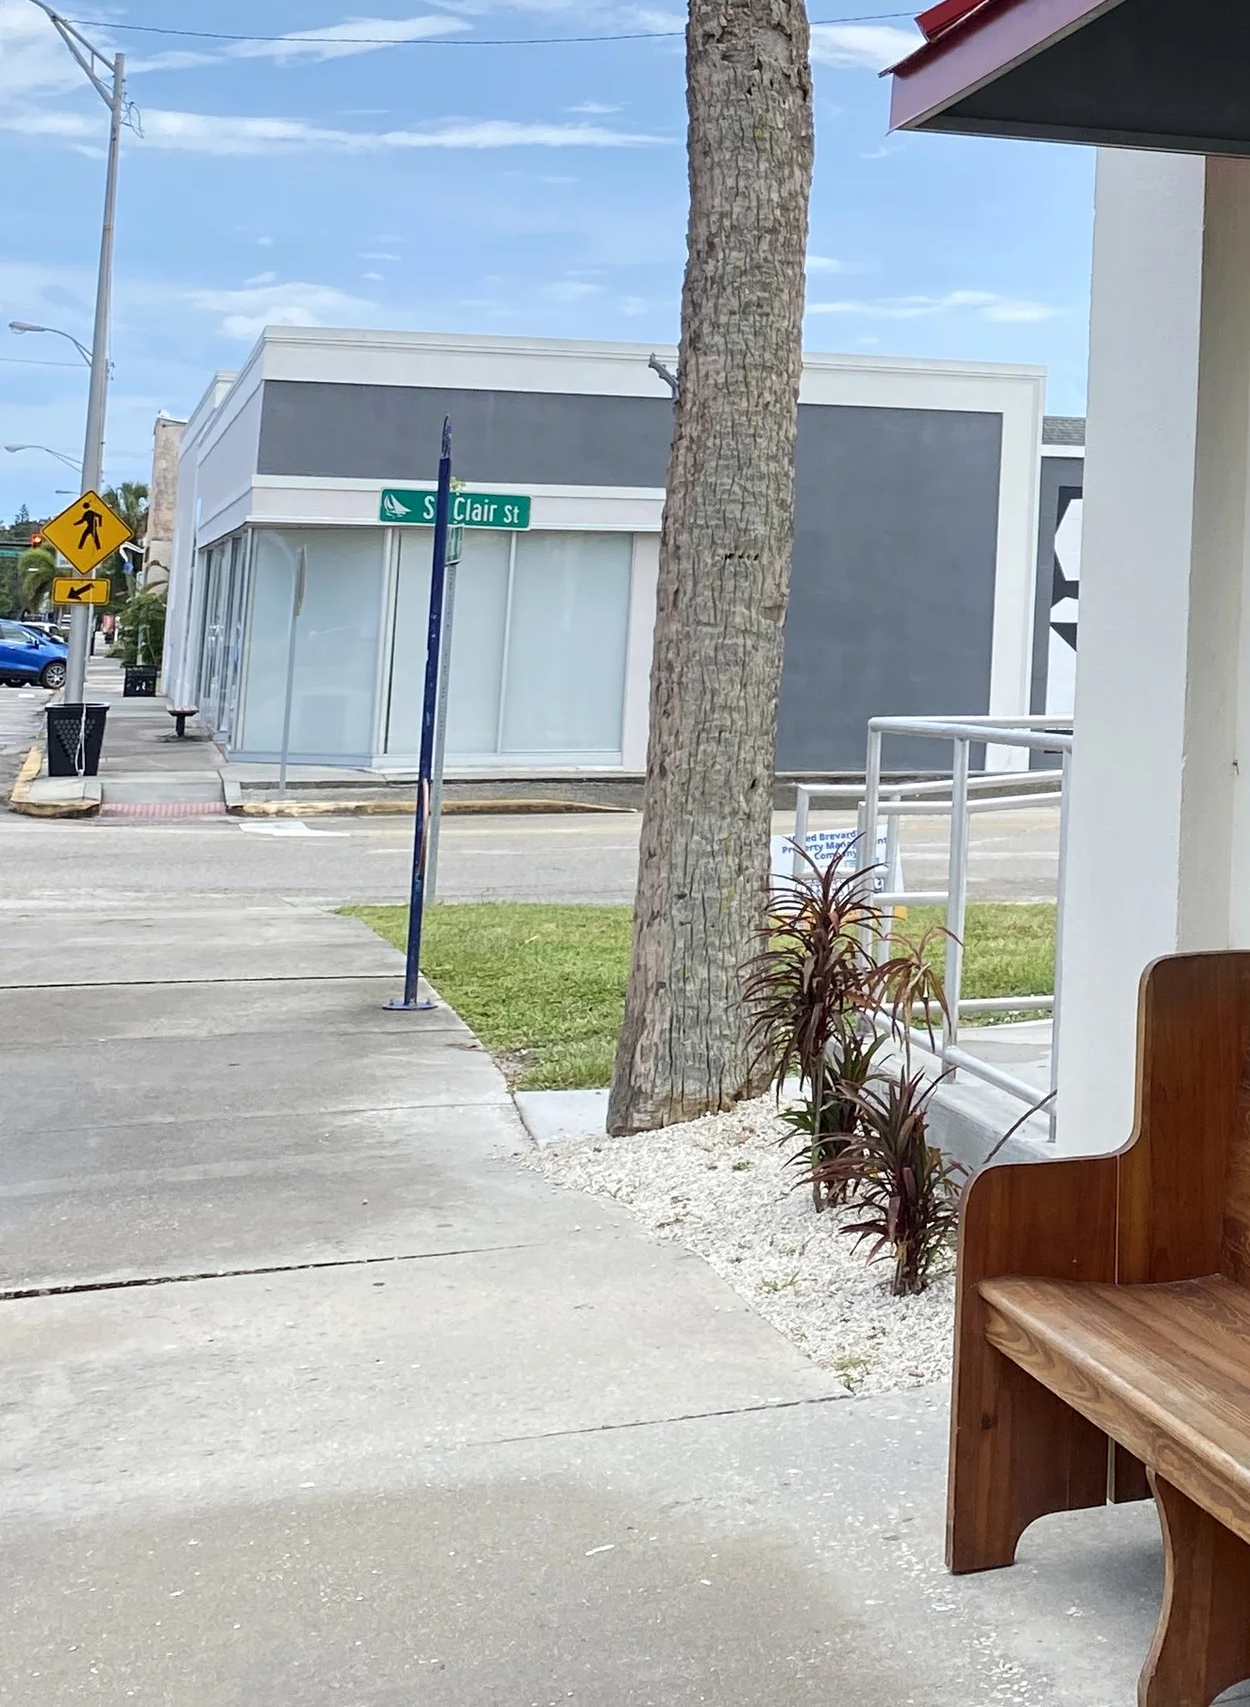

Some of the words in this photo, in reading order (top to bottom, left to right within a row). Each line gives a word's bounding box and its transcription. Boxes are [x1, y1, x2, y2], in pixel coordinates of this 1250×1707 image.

[423, 495, 436, 520] S
[453, 496, 498, 522] Clair
[503, 504, 520, 524] St
[819, 830, 857, 842] Brevard
